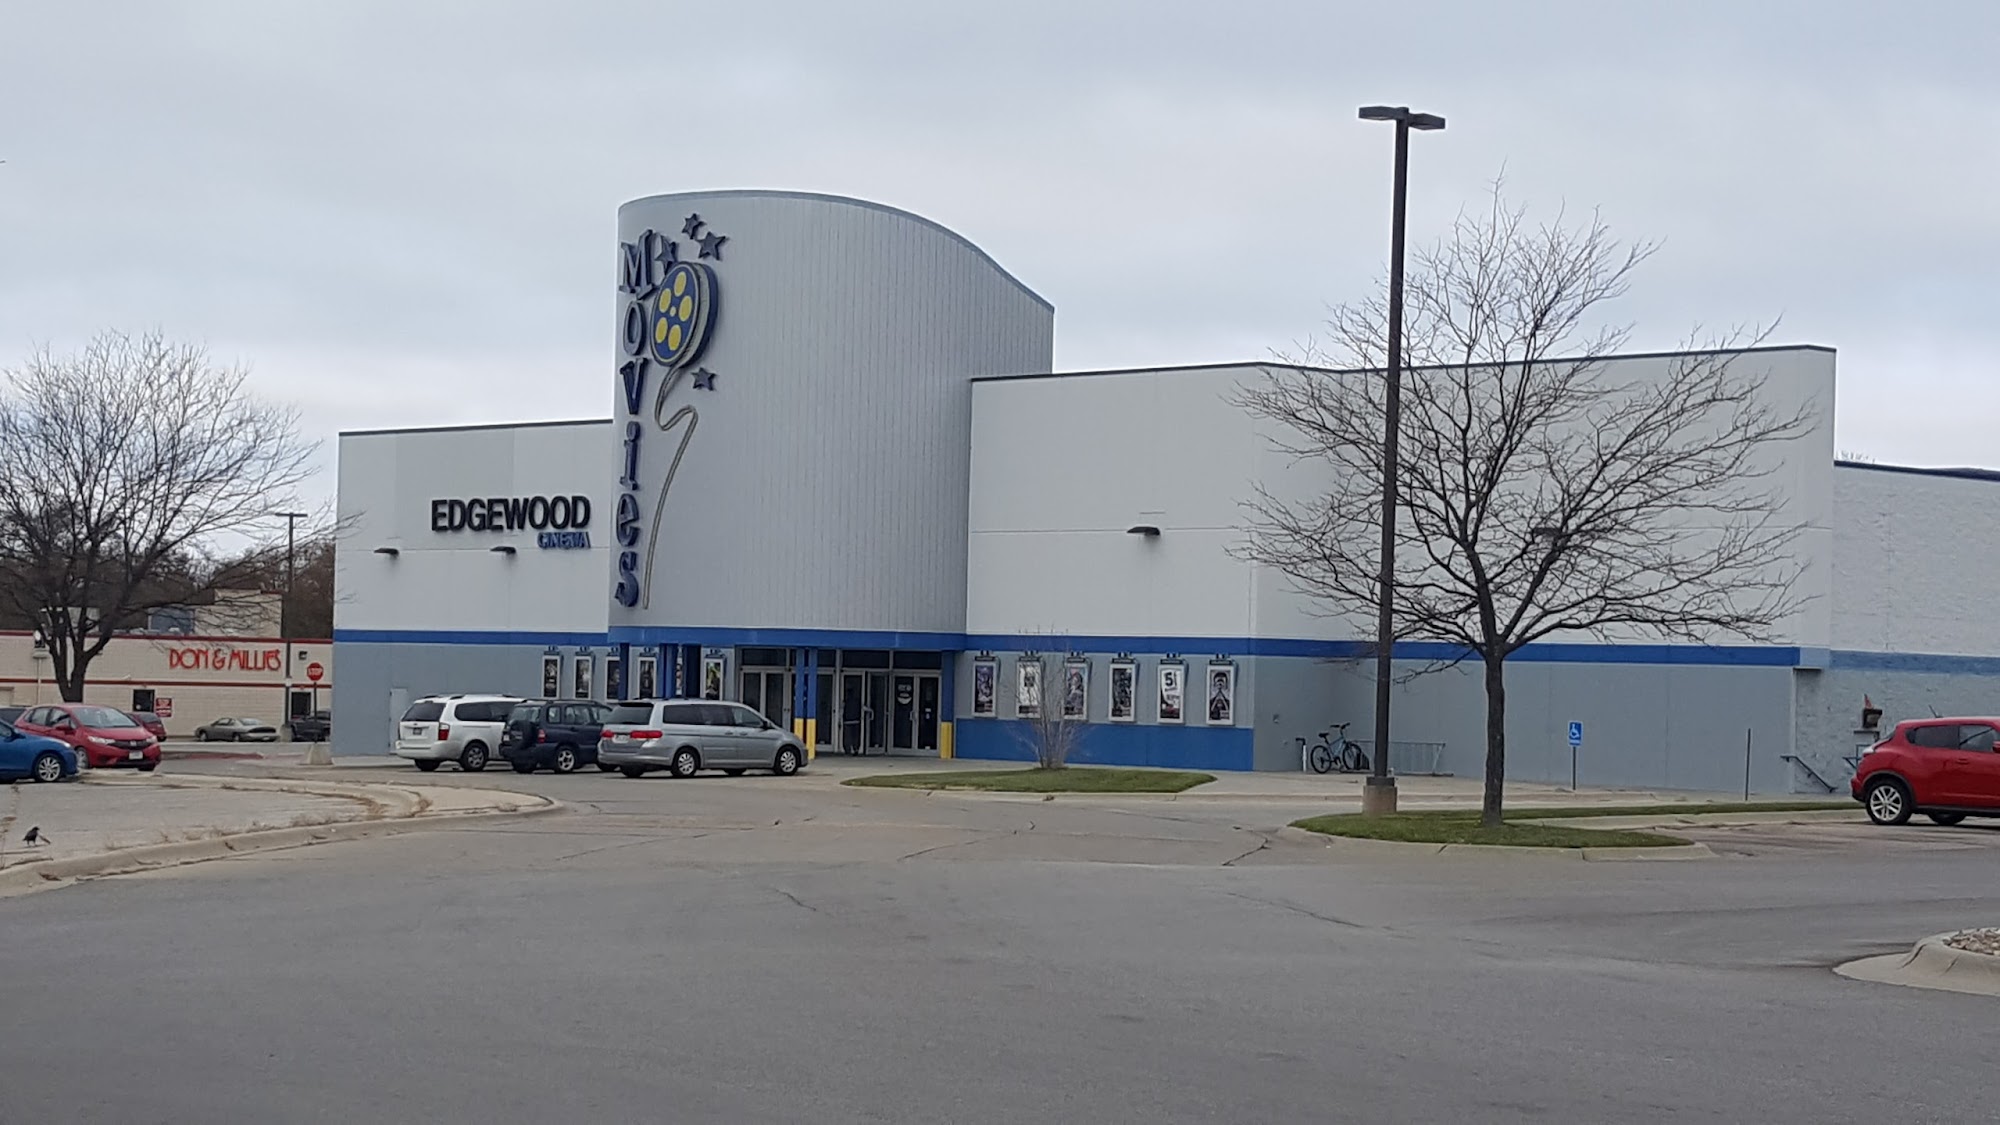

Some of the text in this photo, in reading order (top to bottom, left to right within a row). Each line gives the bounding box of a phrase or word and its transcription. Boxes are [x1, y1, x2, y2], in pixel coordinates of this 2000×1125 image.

[431, 496, 591, 531] EDGEWOOD
[537, 531, 591, 549] CINEMA
[212, 648, 226, 671] &
